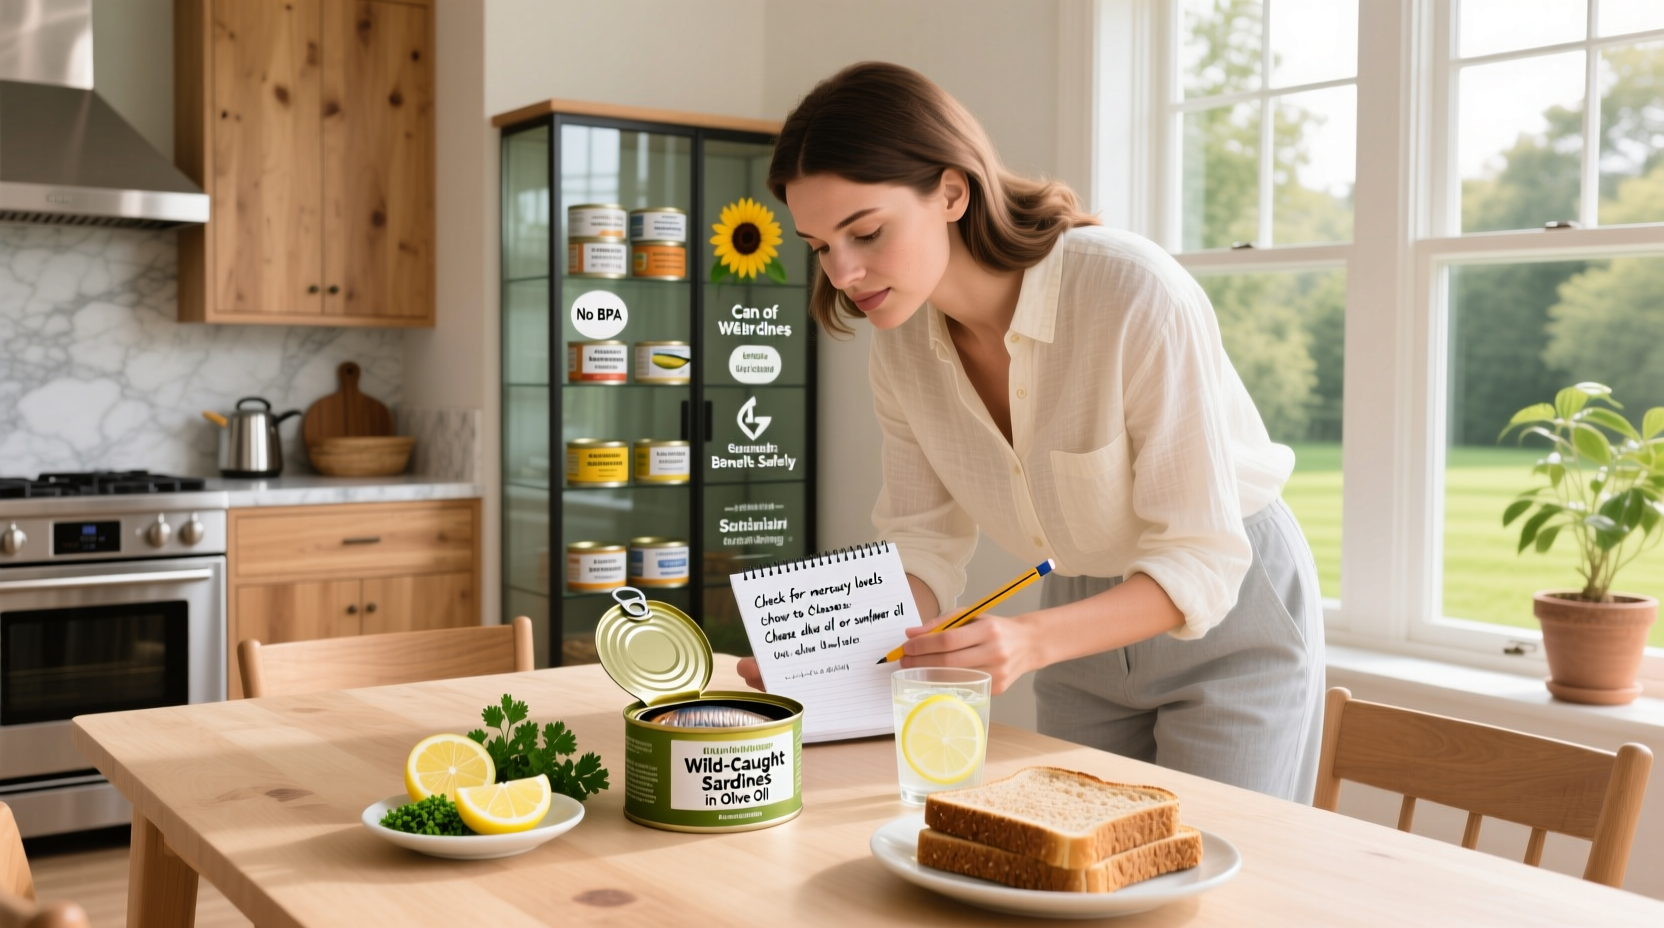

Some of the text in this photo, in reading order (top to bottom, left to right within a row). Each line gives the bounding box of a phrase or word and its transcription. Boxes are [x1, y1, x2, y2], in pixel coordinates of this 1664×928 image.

[576, 307, 623, 321] No BPA
[731, 304, 779, 319] Can of
[789, 587, 806, 603] for
[839, 618, 851, 627] or
[684, 750, 786, 773] Wild-Caught
[701, 773, 773, 791] Sardines
[705, 794, 717, 806] in
[720, 791, 751, 805] Olive
